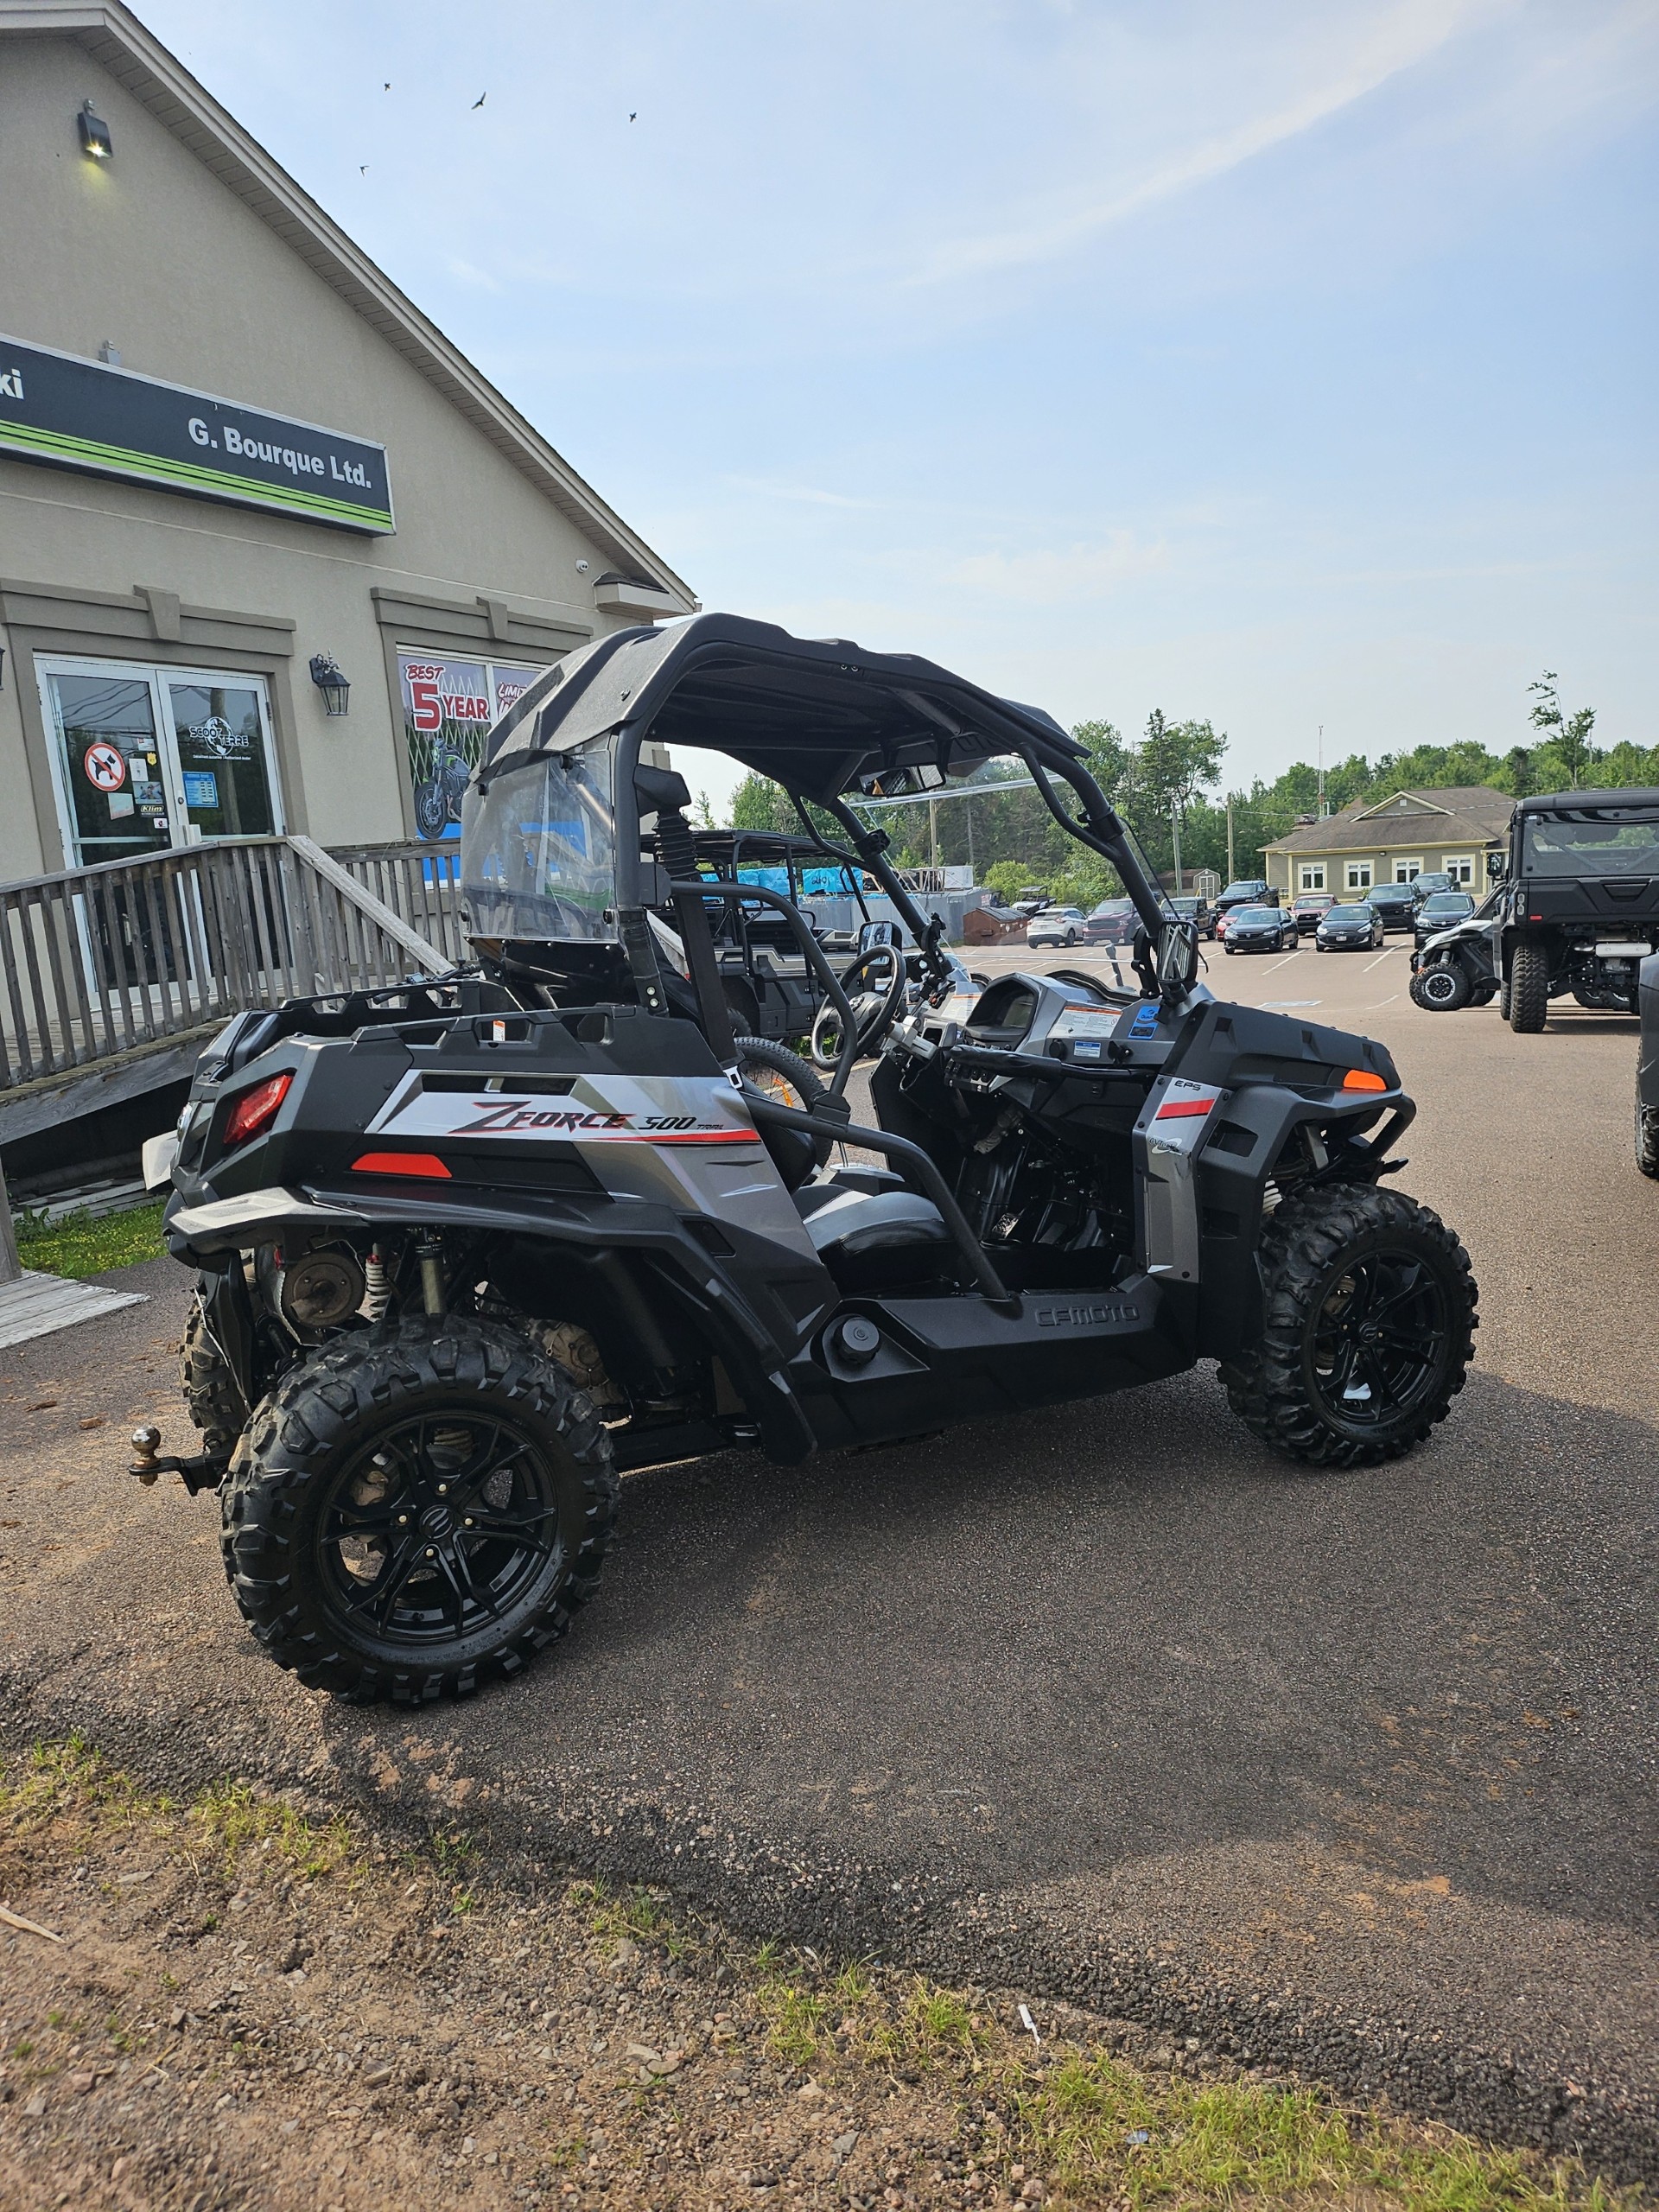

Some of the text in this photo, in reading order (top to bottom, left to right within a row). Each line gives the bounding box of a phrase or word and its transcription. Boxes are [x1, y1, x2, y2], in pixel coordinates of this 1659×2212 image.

[0, 368, 24, 399] ki
[188, 417, 372, 489] G. Bourque Ltd.
[406, 664, 446, 681] BEST
[410, 681, 442, 730] 5
[442, 694, 488, 721] YEAR
[188, 726, 222, 738] SCOOT
[219, 734, 249, 747] TERRE
[1173, 1079, 1203, 1091] EPS
[638, 1116, 697, 1130] 500
[1035, 1303, 1140, 1326] CFMOTO
